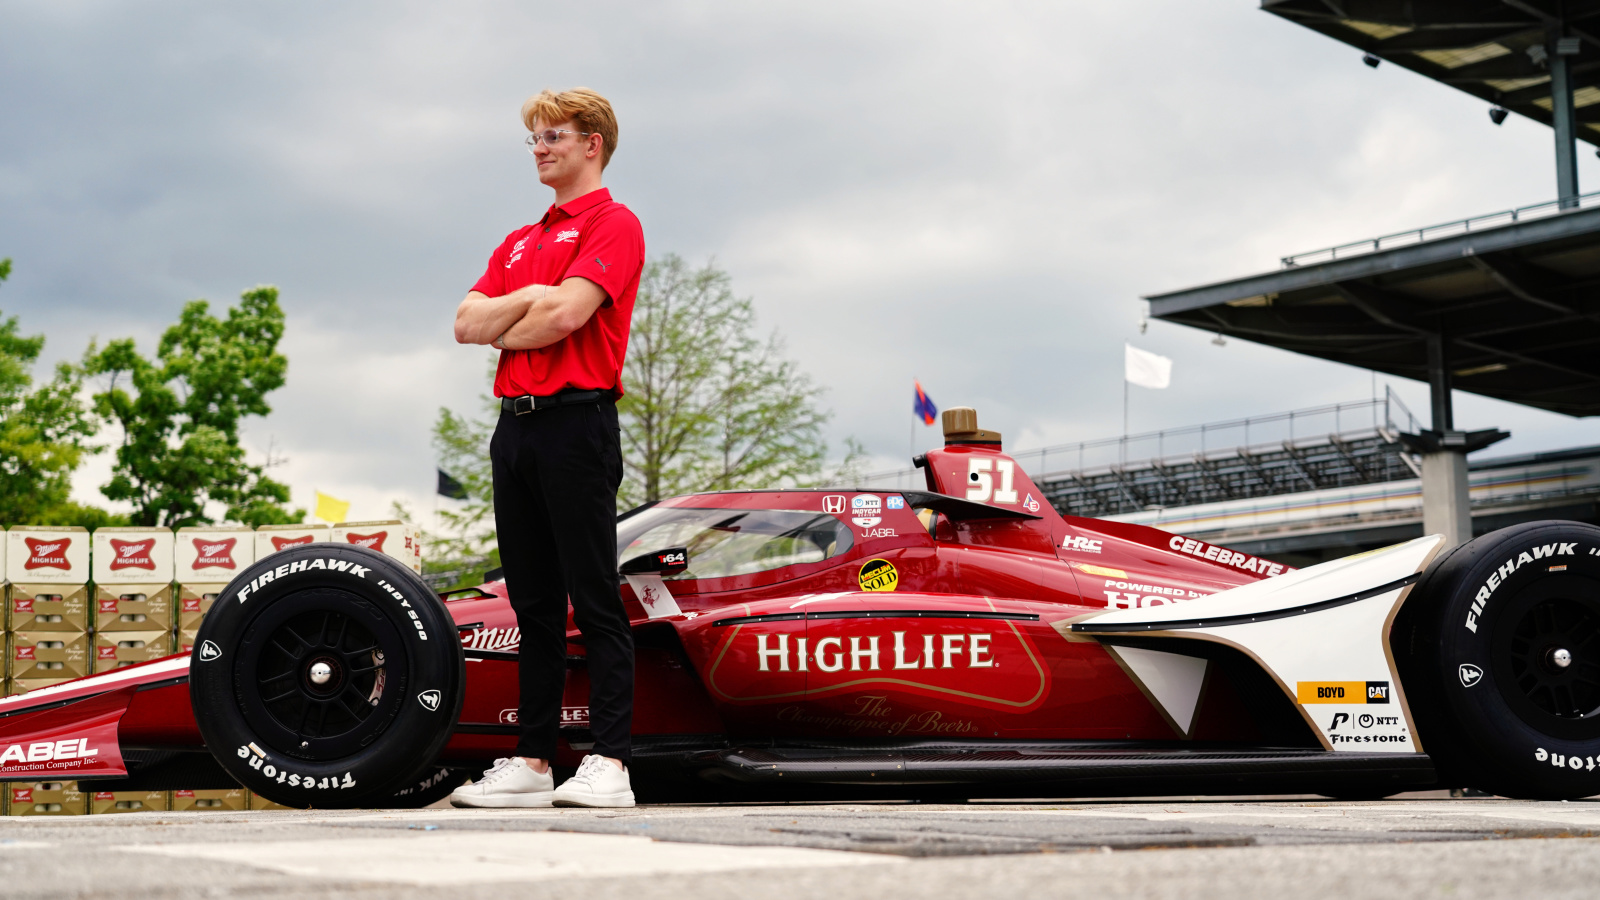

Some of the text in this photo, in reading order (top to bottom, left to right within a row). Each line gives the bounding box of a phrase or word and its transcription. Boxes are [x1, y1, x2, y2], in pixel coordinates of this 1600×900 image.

[966, 457, 1018, 504] 51
[887, 497, 903, 508] PPG
[861, 528, 899, 538] J.ABEL
[35, 544, 61, 557] Miller
[120, 545, 145, 557] Miller
[201, 544, 227, 557] Miller
[1063, 535, 1103, 550] HRC
[1169, 536, 1284, 577] CELEBRATE
[237, 558, 372, 604] FIREHAWK
[861, 564, 891, 581] MECUM
[864, 572, 897, 591] SOLD
[1105, 580, 1185, 596] POWERED
[1465, 543, 1578, 634] FIREHAWK
[460, 627, 521, 650] Mill
[755, 630, 995, 673] HIGH LIFE
[1317, 686, 1388, 698] BOYD CAT
[846, 695, 891, 717] The
[776, 705, 972, 735] Champagne of Beers
[1376, 717, 1398, 725] NTT
[1330, 734, 1406, 744] Firestone
[0, 738, 98, 763] ABEL
[46, 759, 82, 769] Company
[237, 745, 357, 789] Firestone
